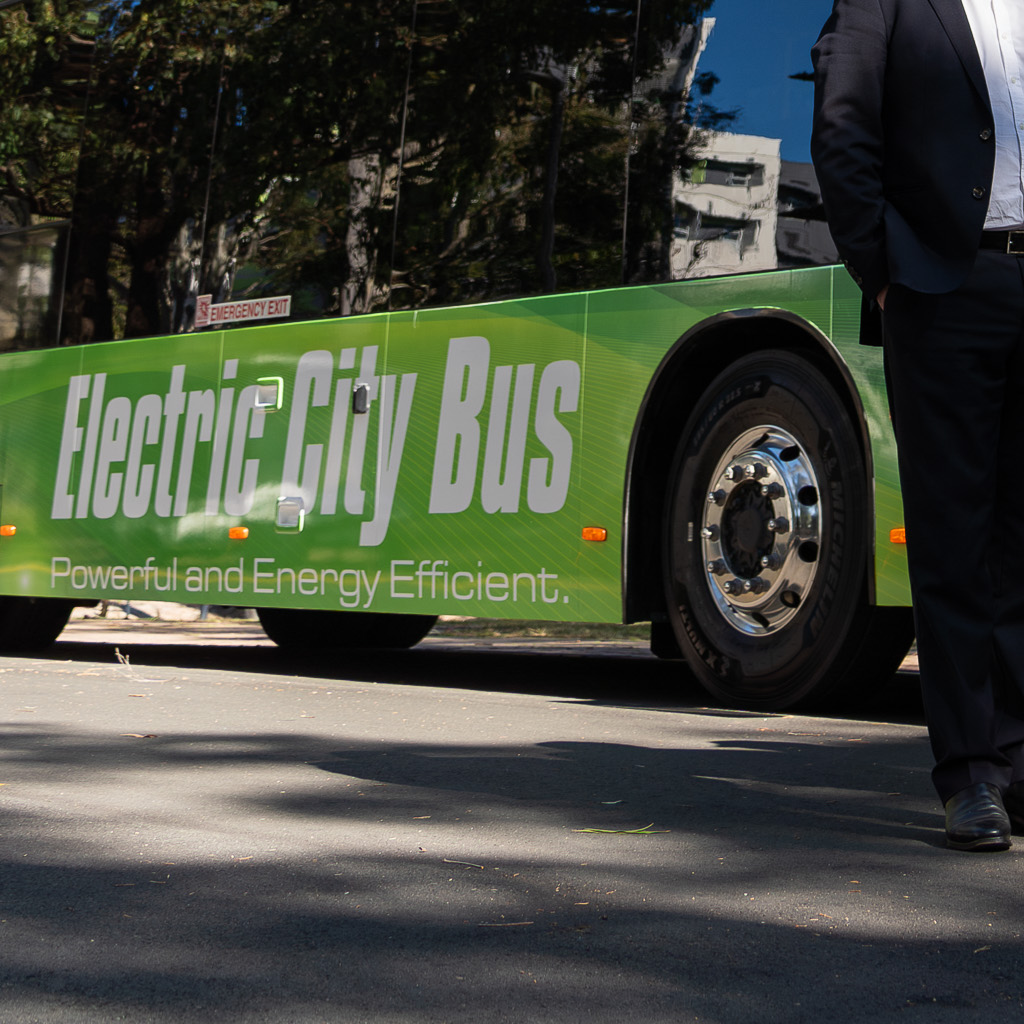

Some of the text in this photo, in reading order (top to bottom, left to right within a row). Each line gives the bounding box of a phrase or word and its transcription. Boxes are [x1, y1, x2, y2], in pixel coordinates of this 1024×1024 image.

[211, 299, 289, 321] EMERGENCY EXIT
[51, 336, 581, 547] Electric City Bus
[51, 556, 570, 608] Powerful and Energy Efficient.
[810, 479, 845, 639] MICHELIN
